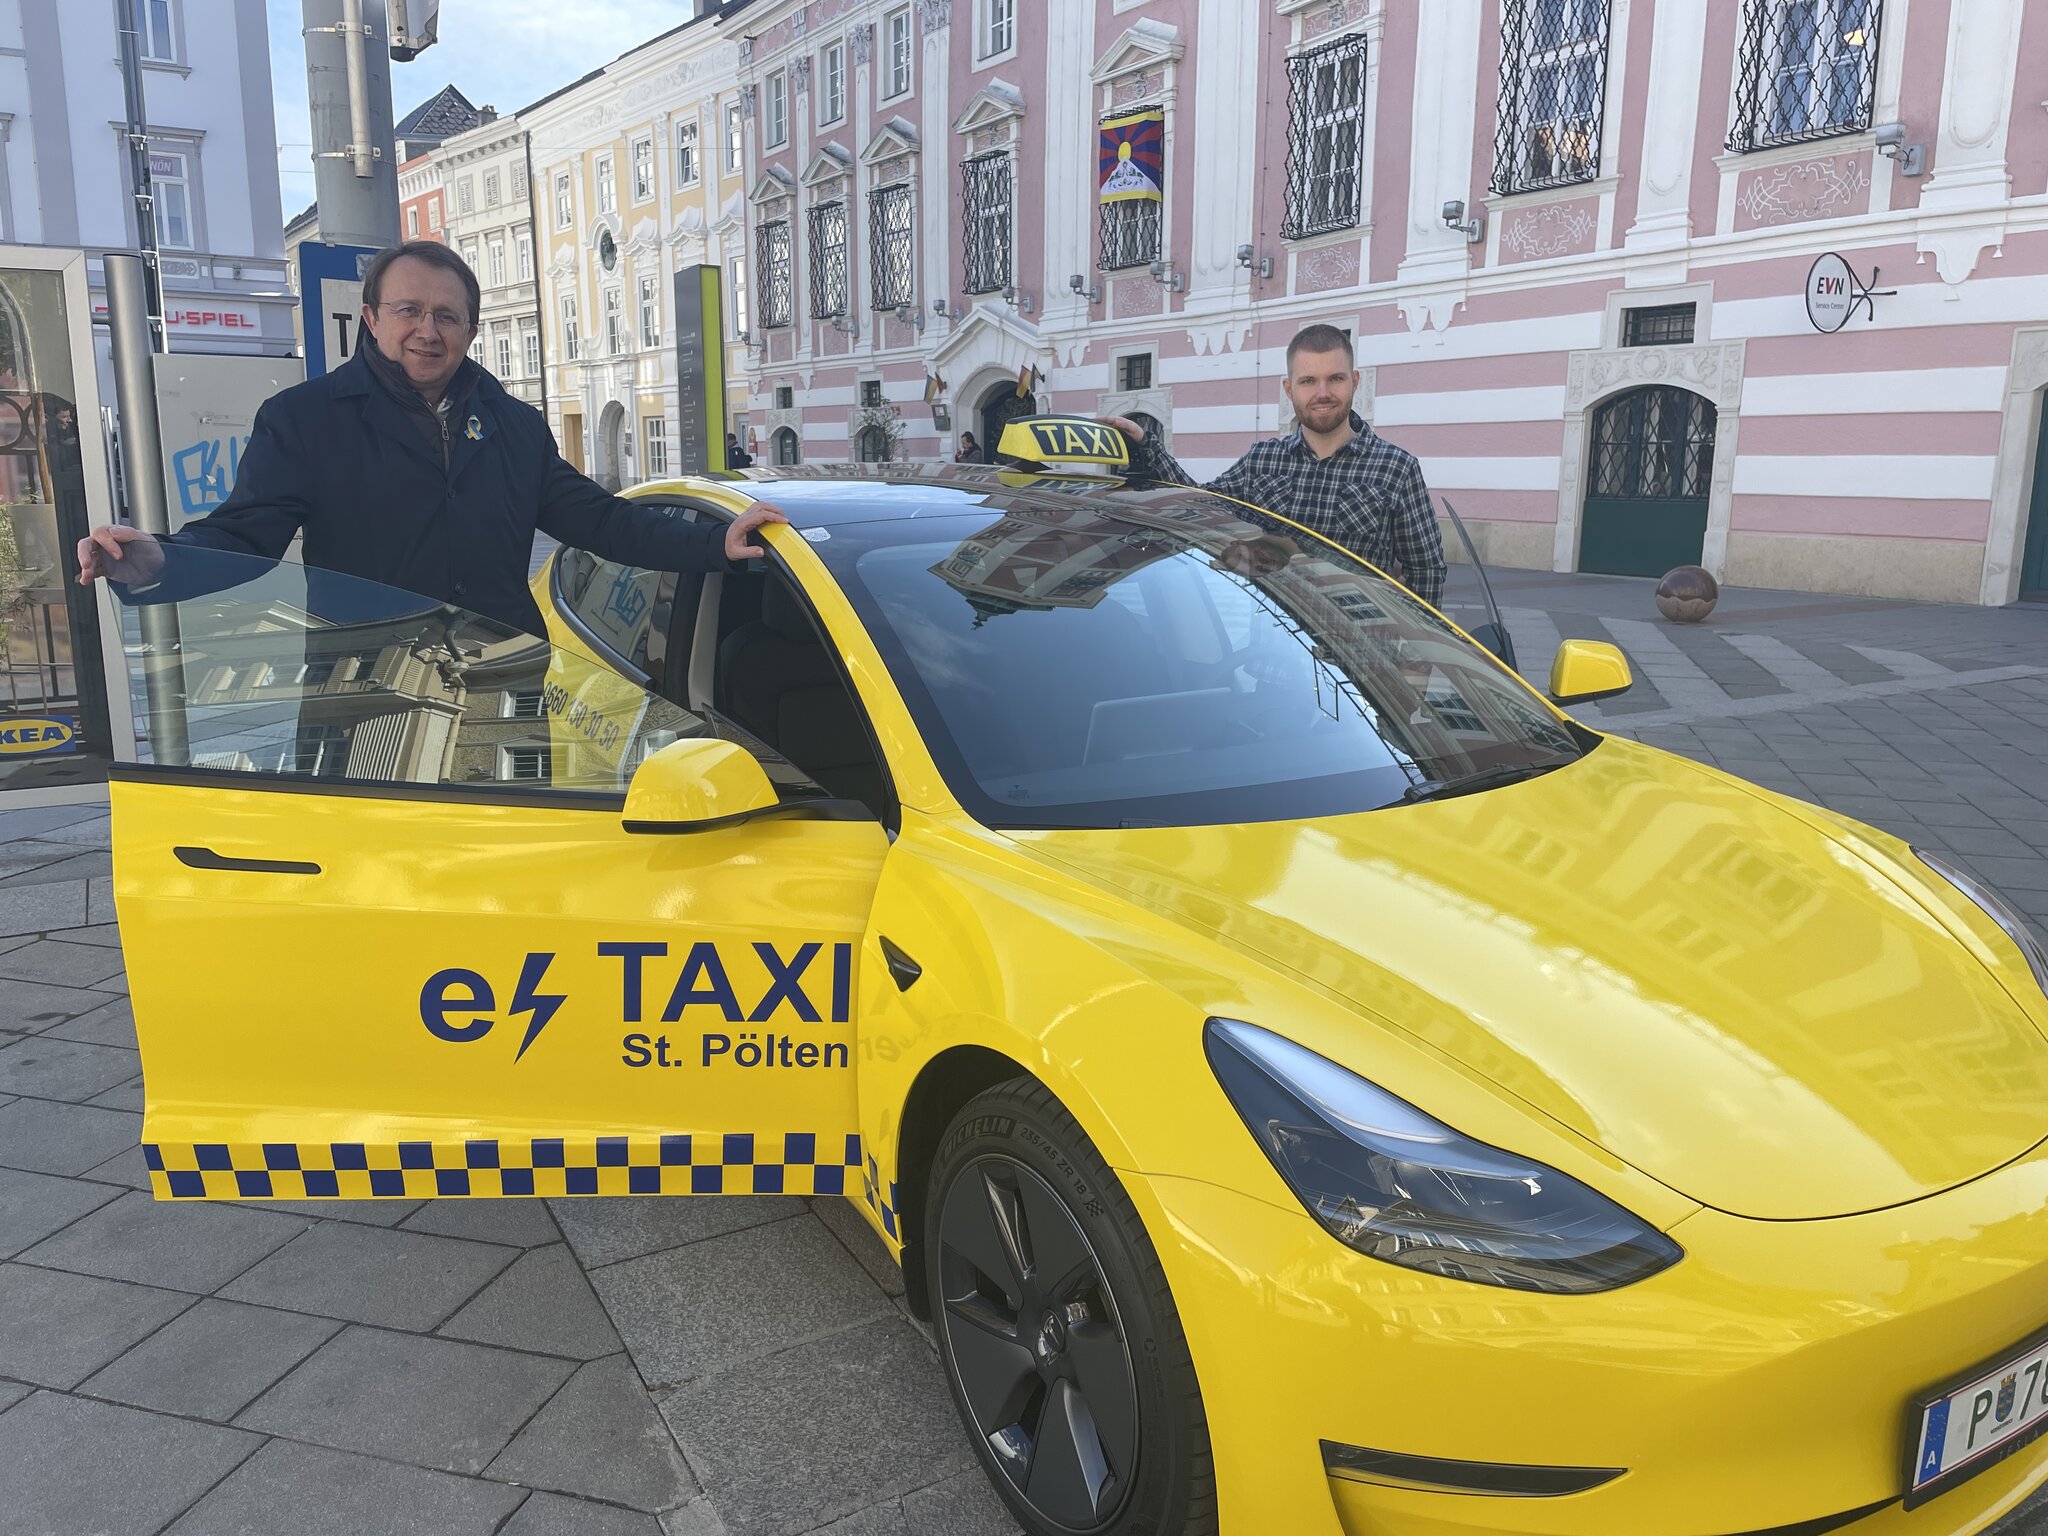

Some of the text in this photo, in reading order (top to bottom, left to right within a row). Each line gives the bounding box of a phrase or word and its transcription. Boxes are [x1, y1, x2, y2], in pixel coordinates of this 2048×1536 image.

[1816, 276, 1845, 295] EVN
[1036, 424, 1119, 457] TAXI
[597, 941, 852, 1024] TAXI
[621, 1033, 682, 1069] St.
[702, 1032, 849, 1069] Pölten
[944, 1116, 1012, 1161] MICHELIN
[1019, 1127, 1087, 1194] 235/45 ZR 18
[1967, 1389, 1993, 1451] P
[1925, 1450, 1937, 1470] A
